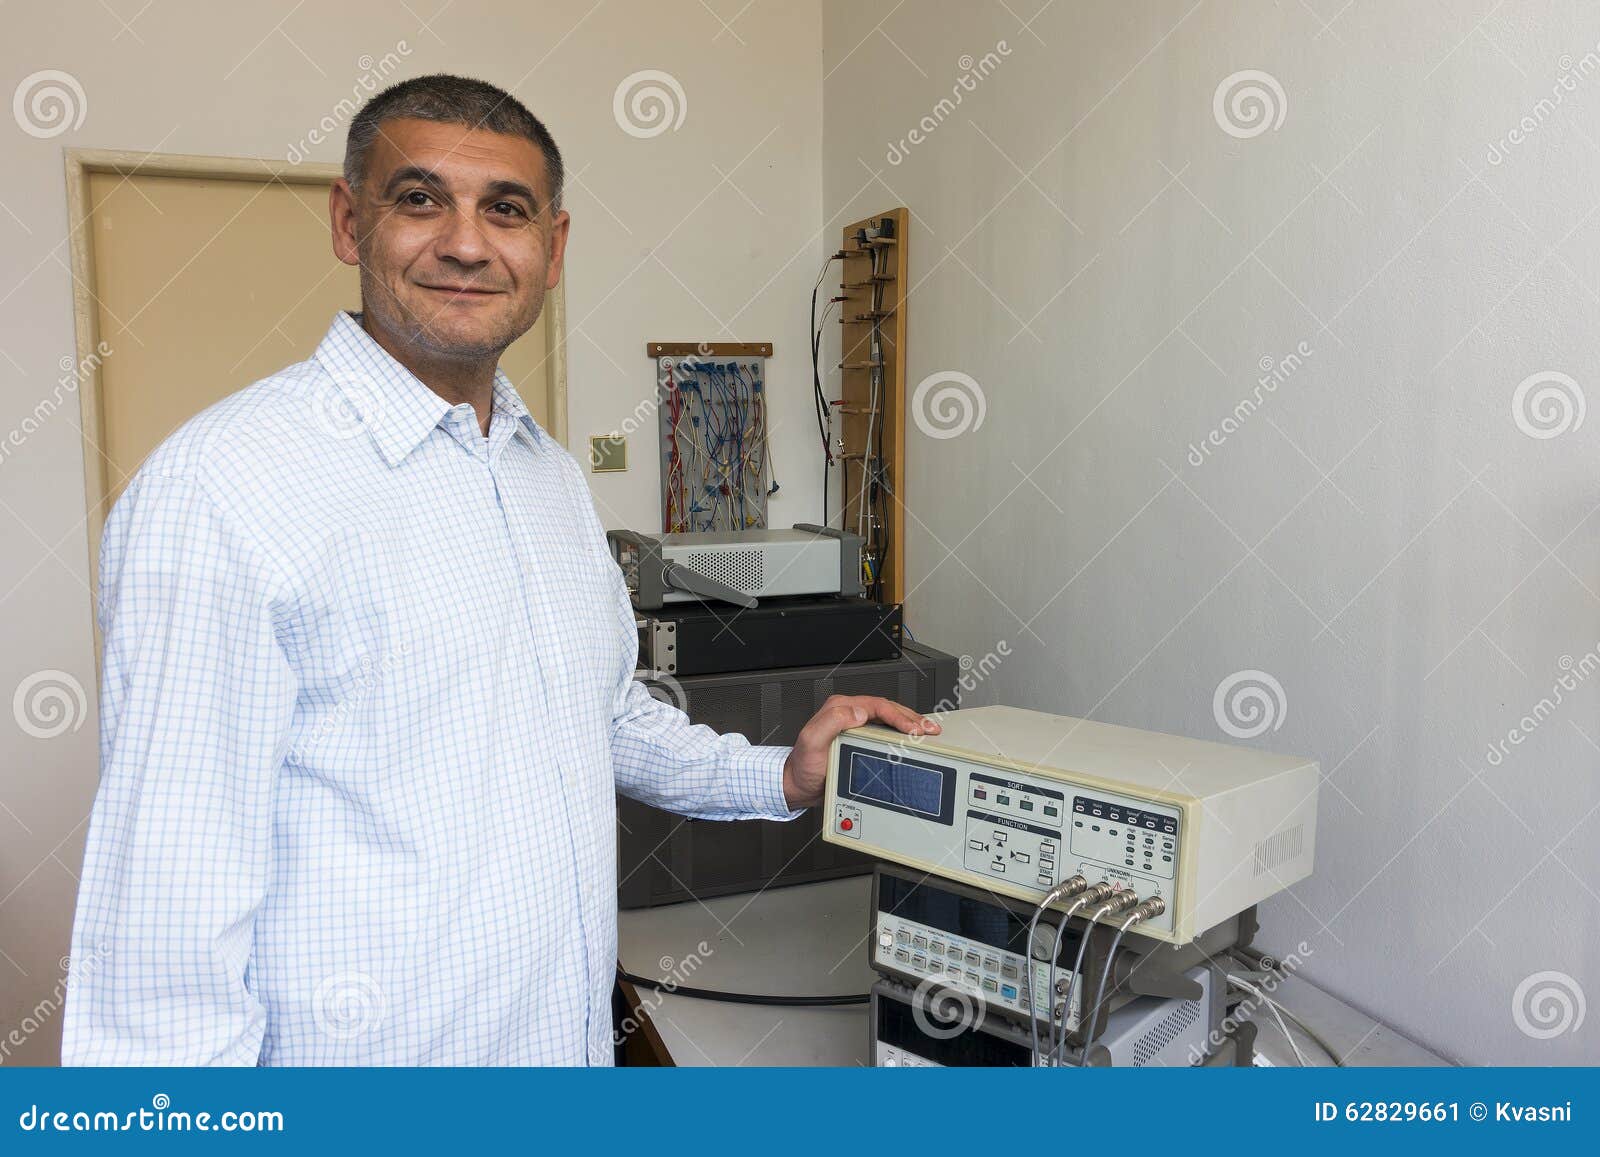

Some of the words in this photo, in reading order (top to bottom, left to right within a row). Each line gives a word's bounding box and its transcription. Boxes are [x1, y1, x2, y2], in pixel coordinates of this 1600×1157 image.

[1007, 781, 1024, 791] SORT
[997, 817, 1029, 831] FUNCTION
[1106, 867, 1131, 877] UNKNOWN
